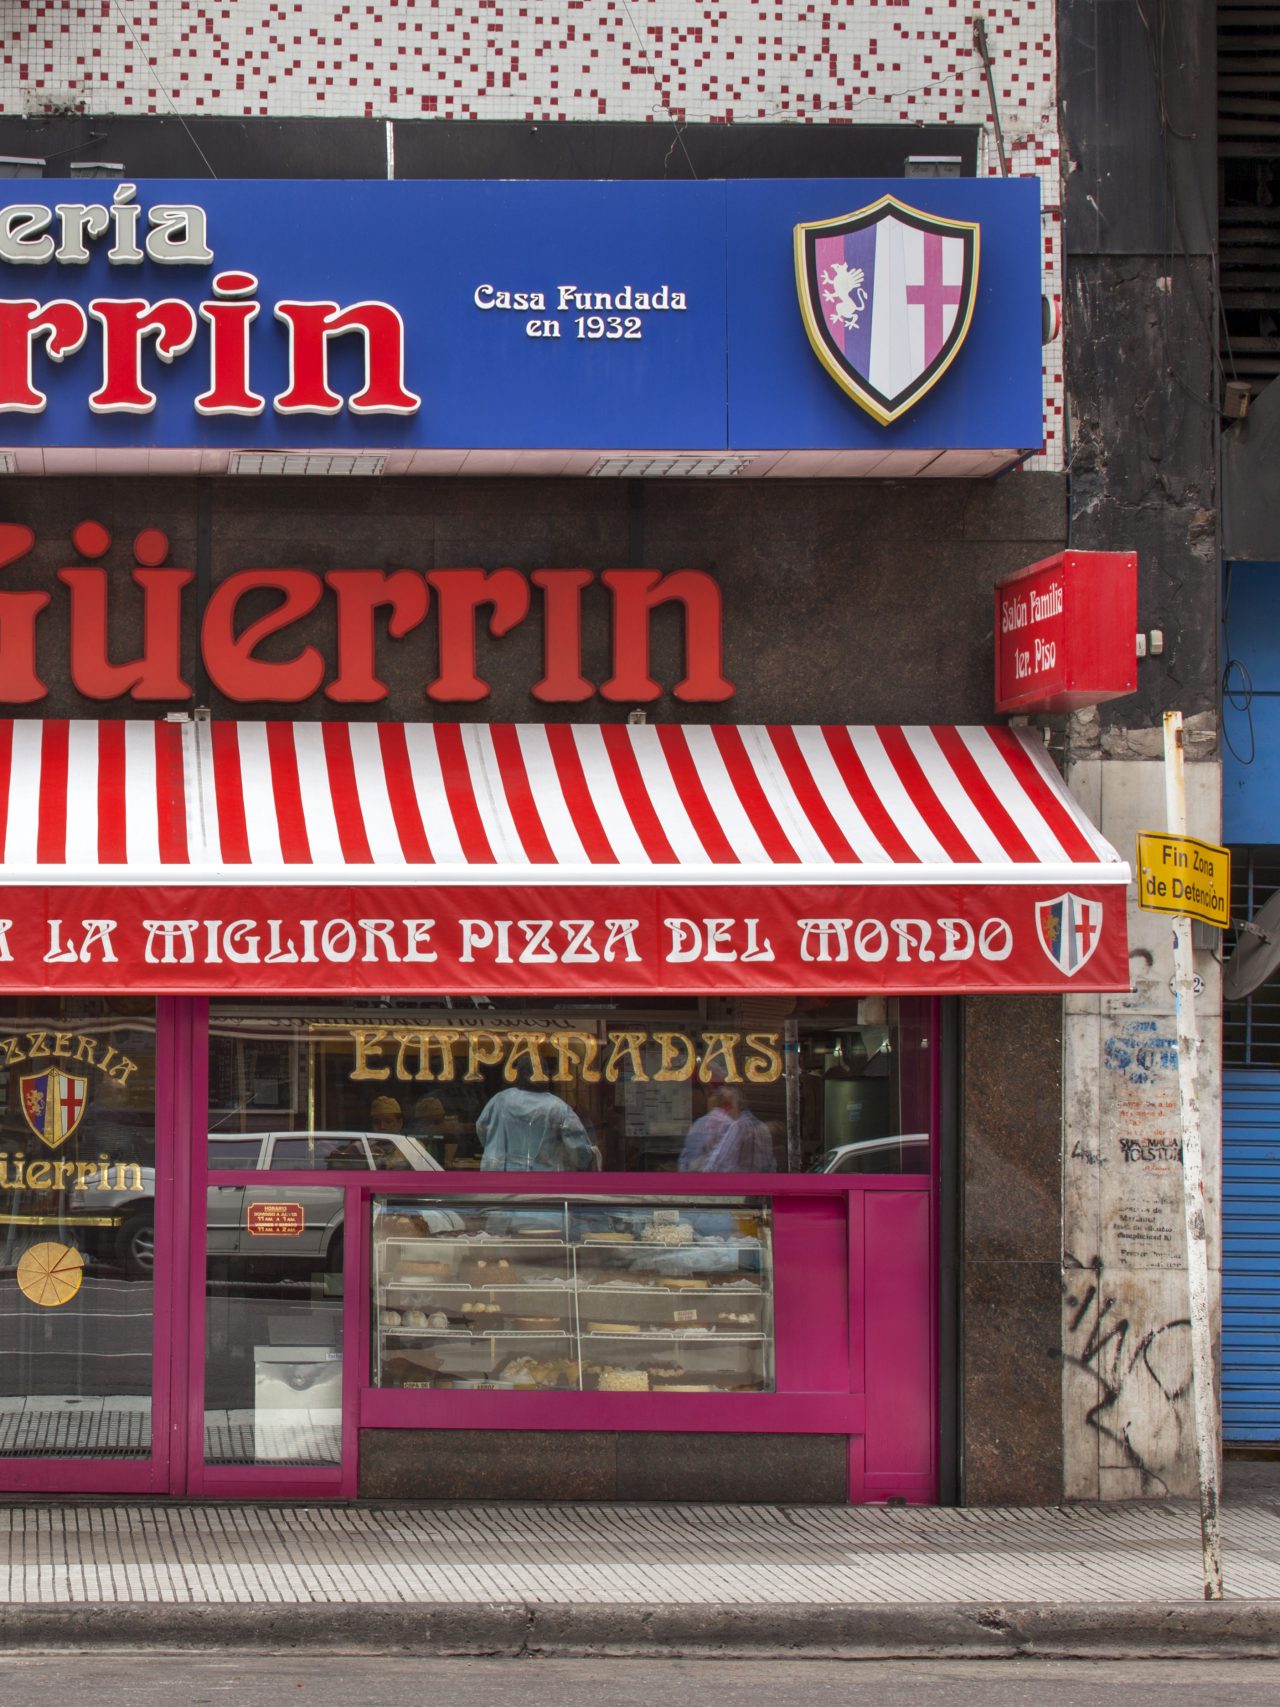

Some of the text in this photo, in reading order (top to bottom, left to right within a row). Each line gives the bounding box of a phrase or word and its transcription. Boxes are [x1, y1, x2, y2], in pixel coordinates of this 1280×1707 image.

[474, 284, 687, 310] Casa Fundada
[526, 316, 642, 339] en 1932
[1002, 582, 1063, 633] Salón Familia
[1014, 638, 1056, 679] 1er. Piso
[1162, 844, 1214, 877] Fin Zona
[1146, 876, 1167, 897] de
[44, 919, 119, 964] LA
[143, 919, 438, 965] MIGLIORE
[458, 918, 642, 964] PIZZA
[664, 917, 775, 963] DEL
[797, 916, 1014, 964] MONDO
[349, 1028, 784, 1083] EMPANADAS
